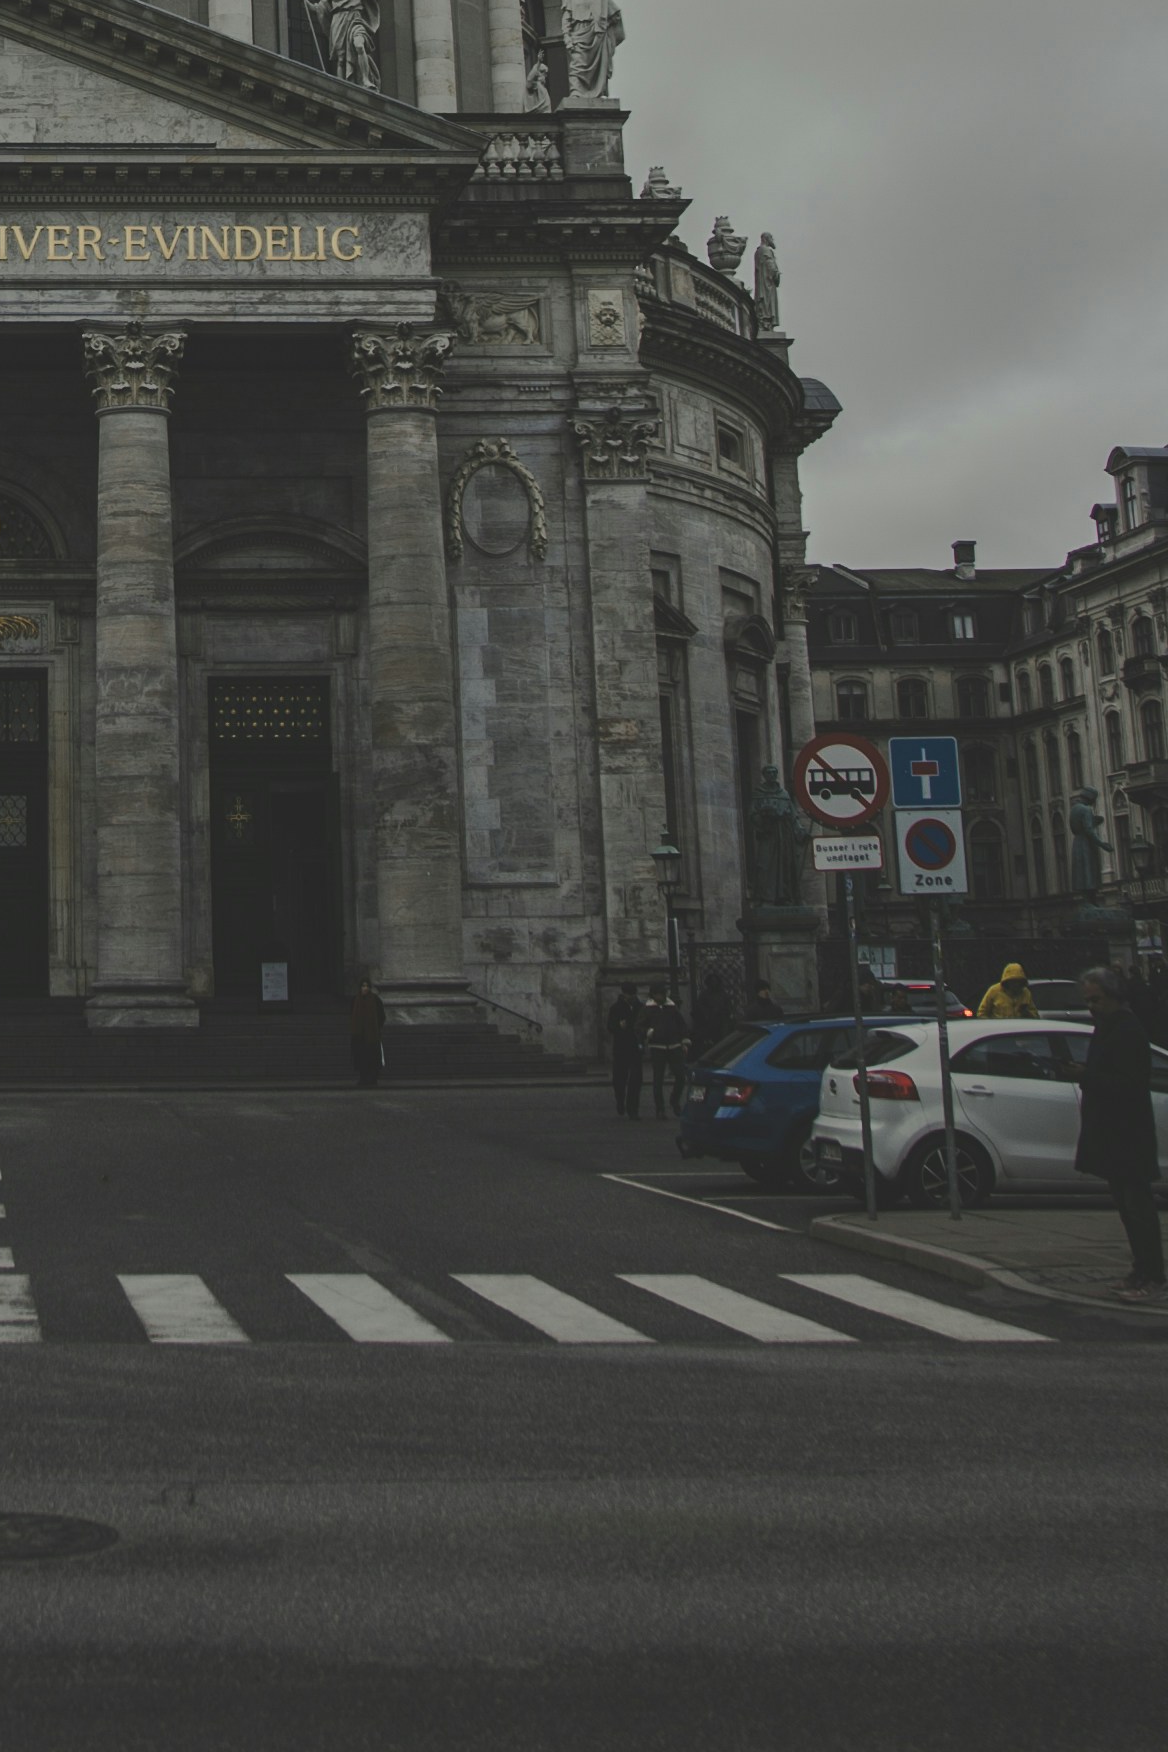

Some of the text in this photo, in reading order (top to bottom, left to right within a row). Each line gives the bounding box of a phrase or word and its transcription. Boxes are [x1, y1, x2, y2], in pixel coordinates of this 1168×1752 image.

[123, 224, 363, 261] EVINDELIG
[815, 844, 848, 853] Busser
[858, 842, 879, 851] rute
[826, 853, 870, 863] undtaget
[915, 873, 953, 887] Zone
